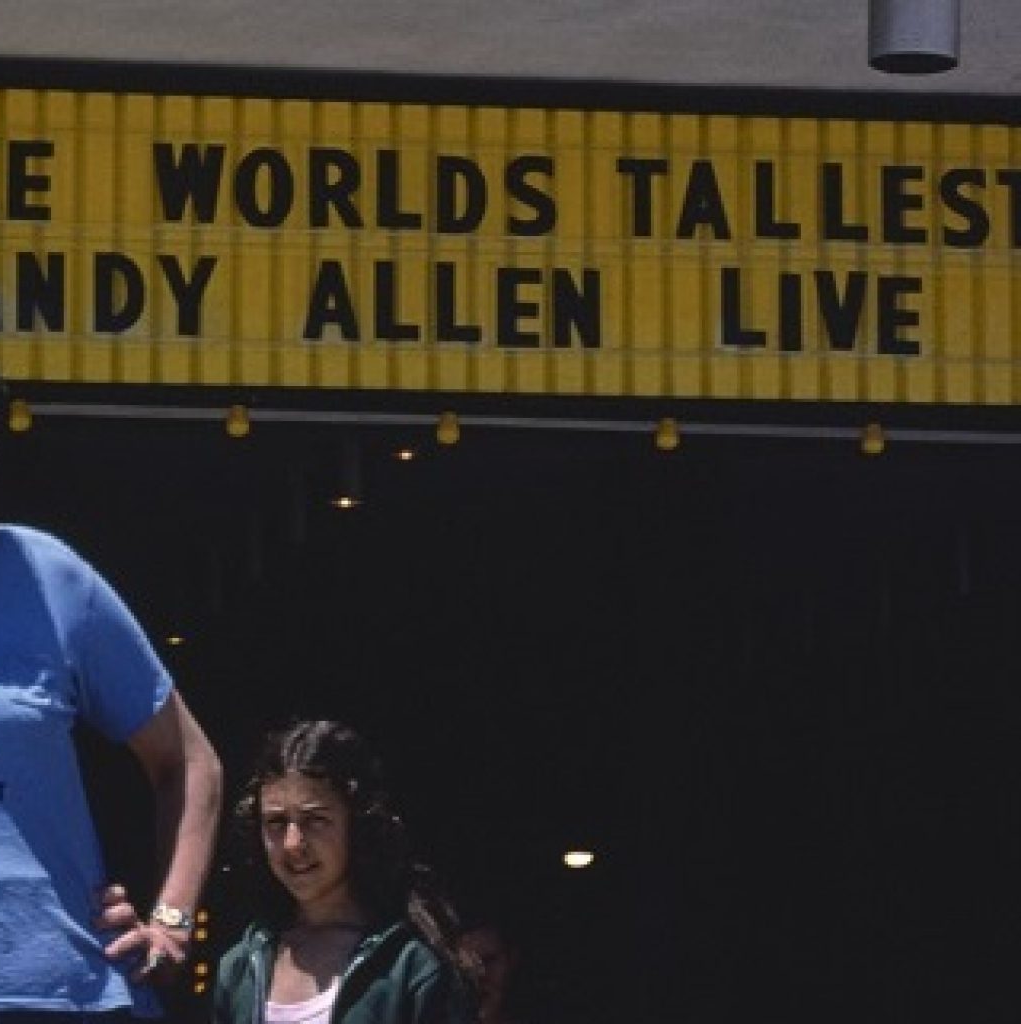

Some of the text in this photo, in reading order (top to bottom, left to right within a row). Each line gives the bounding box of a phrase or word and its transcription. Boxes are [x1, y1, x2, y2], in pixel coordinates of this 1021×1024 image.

[153, 143, 557, 237] WORLDS
[302, 260, 601, 349] ALLEN
[720, 267, 923, 355] LIVE
